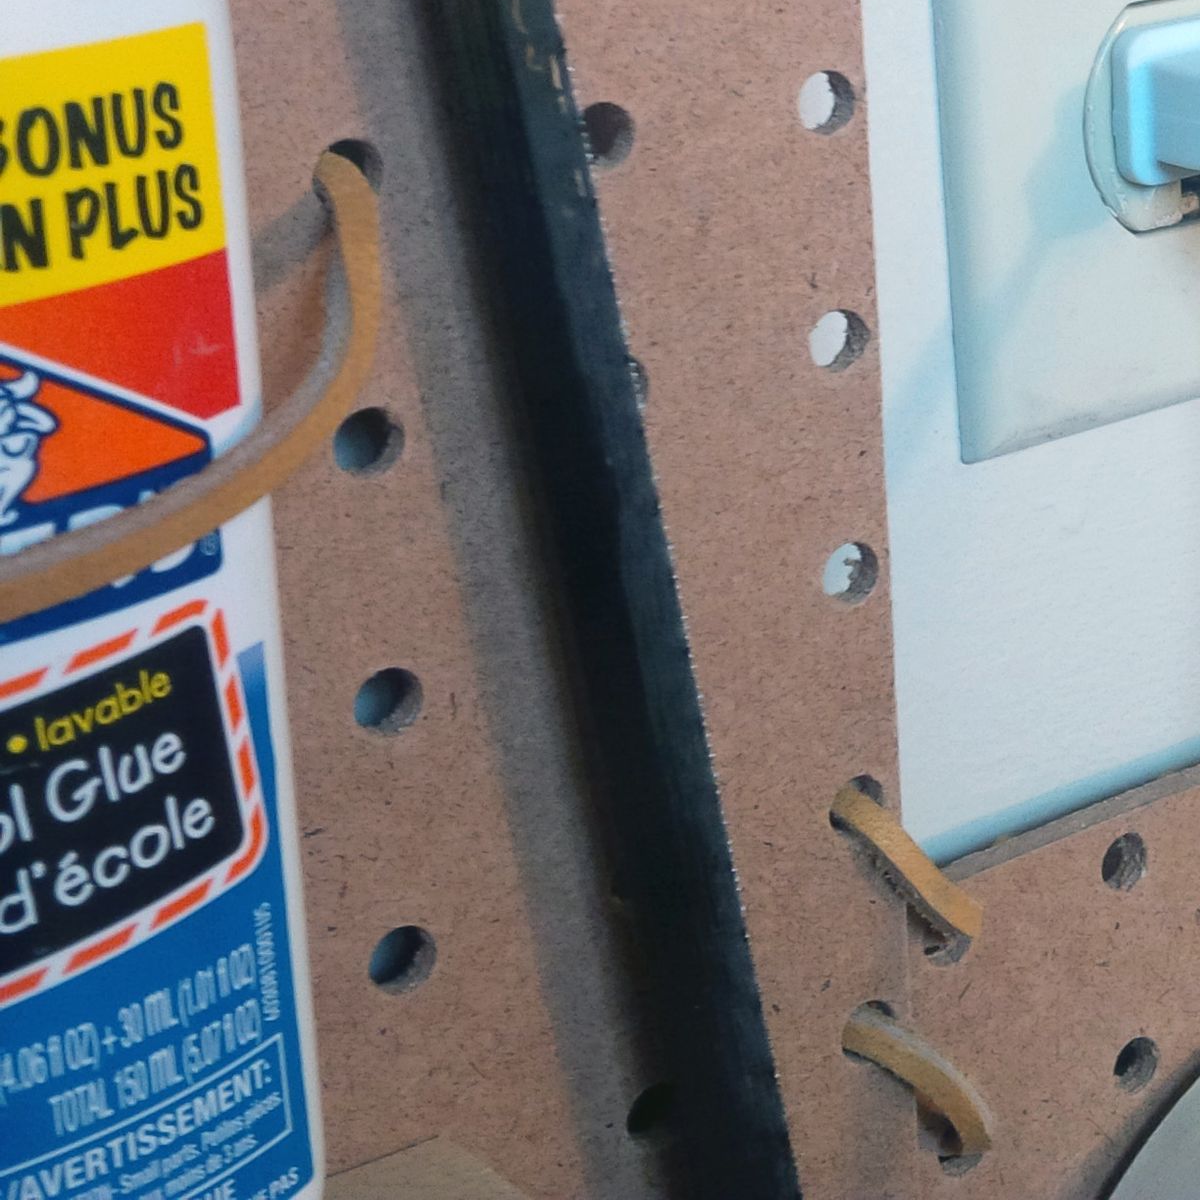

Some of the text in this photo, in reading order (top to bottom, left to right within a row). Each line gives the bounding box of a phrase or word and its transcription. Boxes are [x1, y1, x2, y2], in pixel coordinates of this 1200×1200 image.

[0, 164, 203, 273] N PLUS
[34, 669, 173, 752] lavable
[45, 732, 187, 823] Glue
[0, 795, 216, 934] d'école
[49, 1078, 114, 1137] TOTAL
